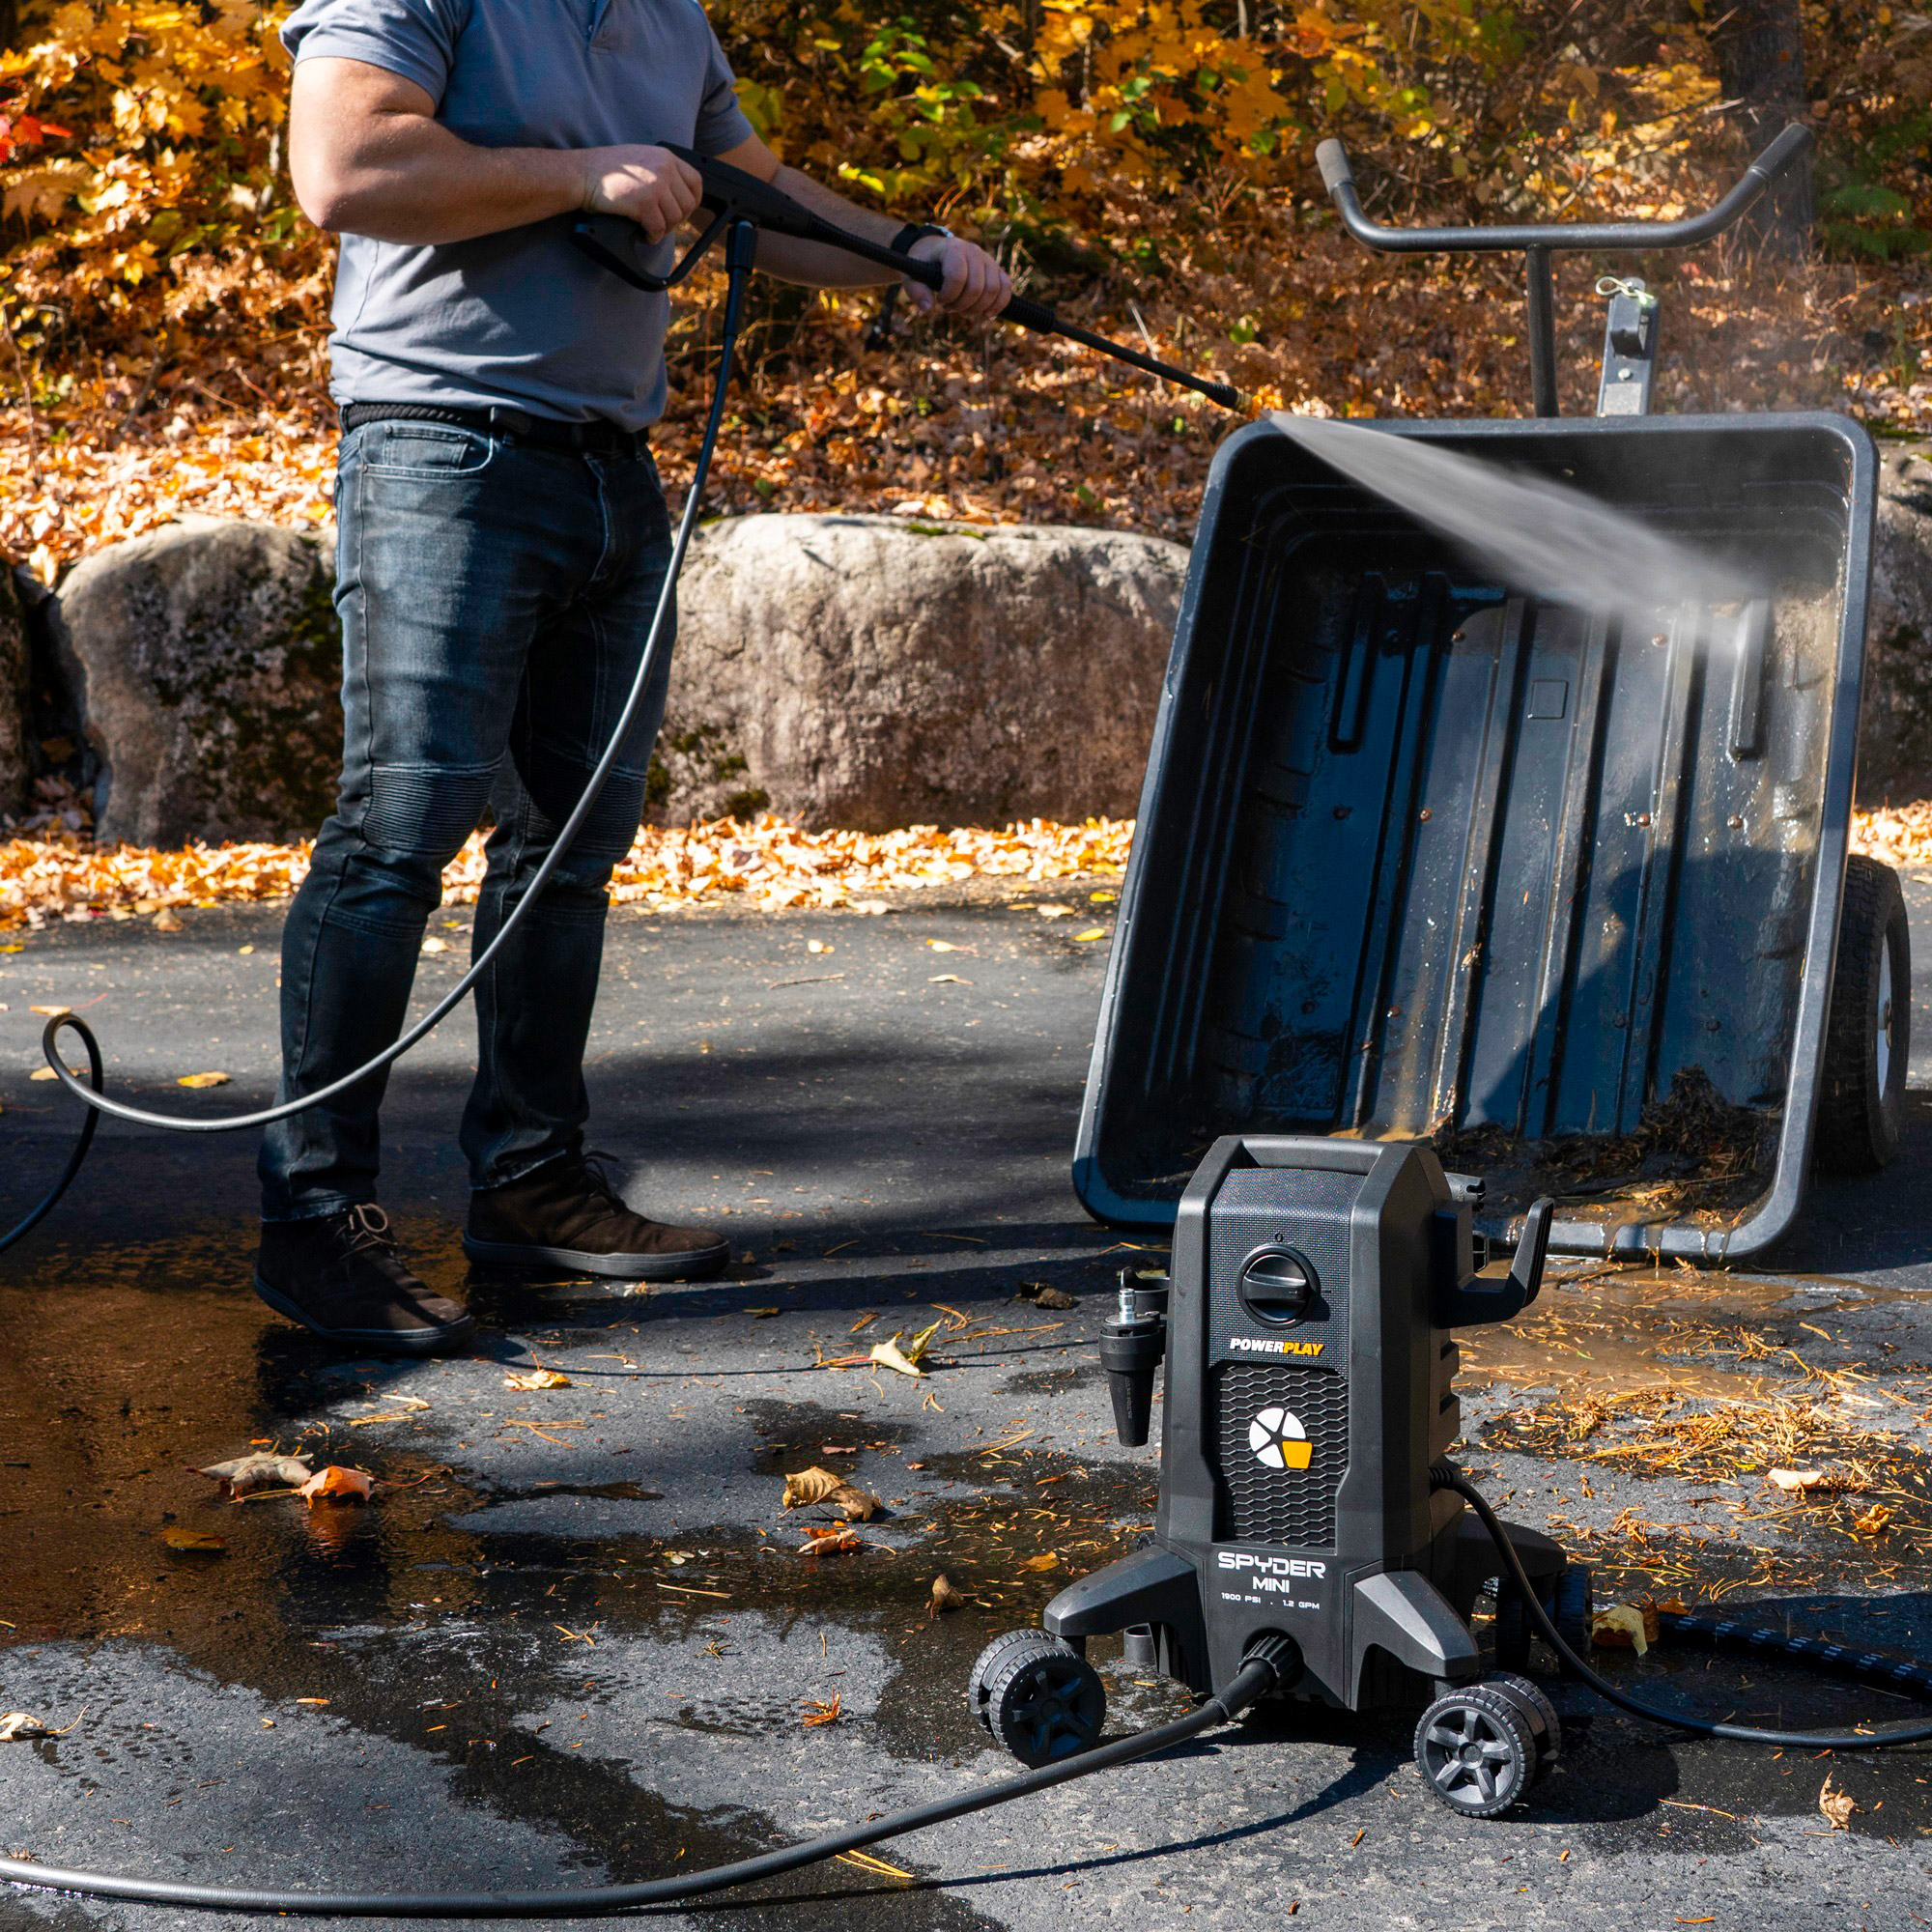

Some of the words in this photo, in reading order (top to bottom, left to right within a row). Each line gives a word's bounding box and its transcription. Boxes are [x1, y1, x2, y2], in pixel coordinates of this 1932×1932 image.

[1230, 1339, 1323, 1356] POWERPLAY
[1218, 1552, 1326, 1578] SPYDER
[1253, 1577, 1290, 1593] MINI
[1221, 1592, 1241, 1601] 1900
[1245, 1595, 1261, 1604] PSI
